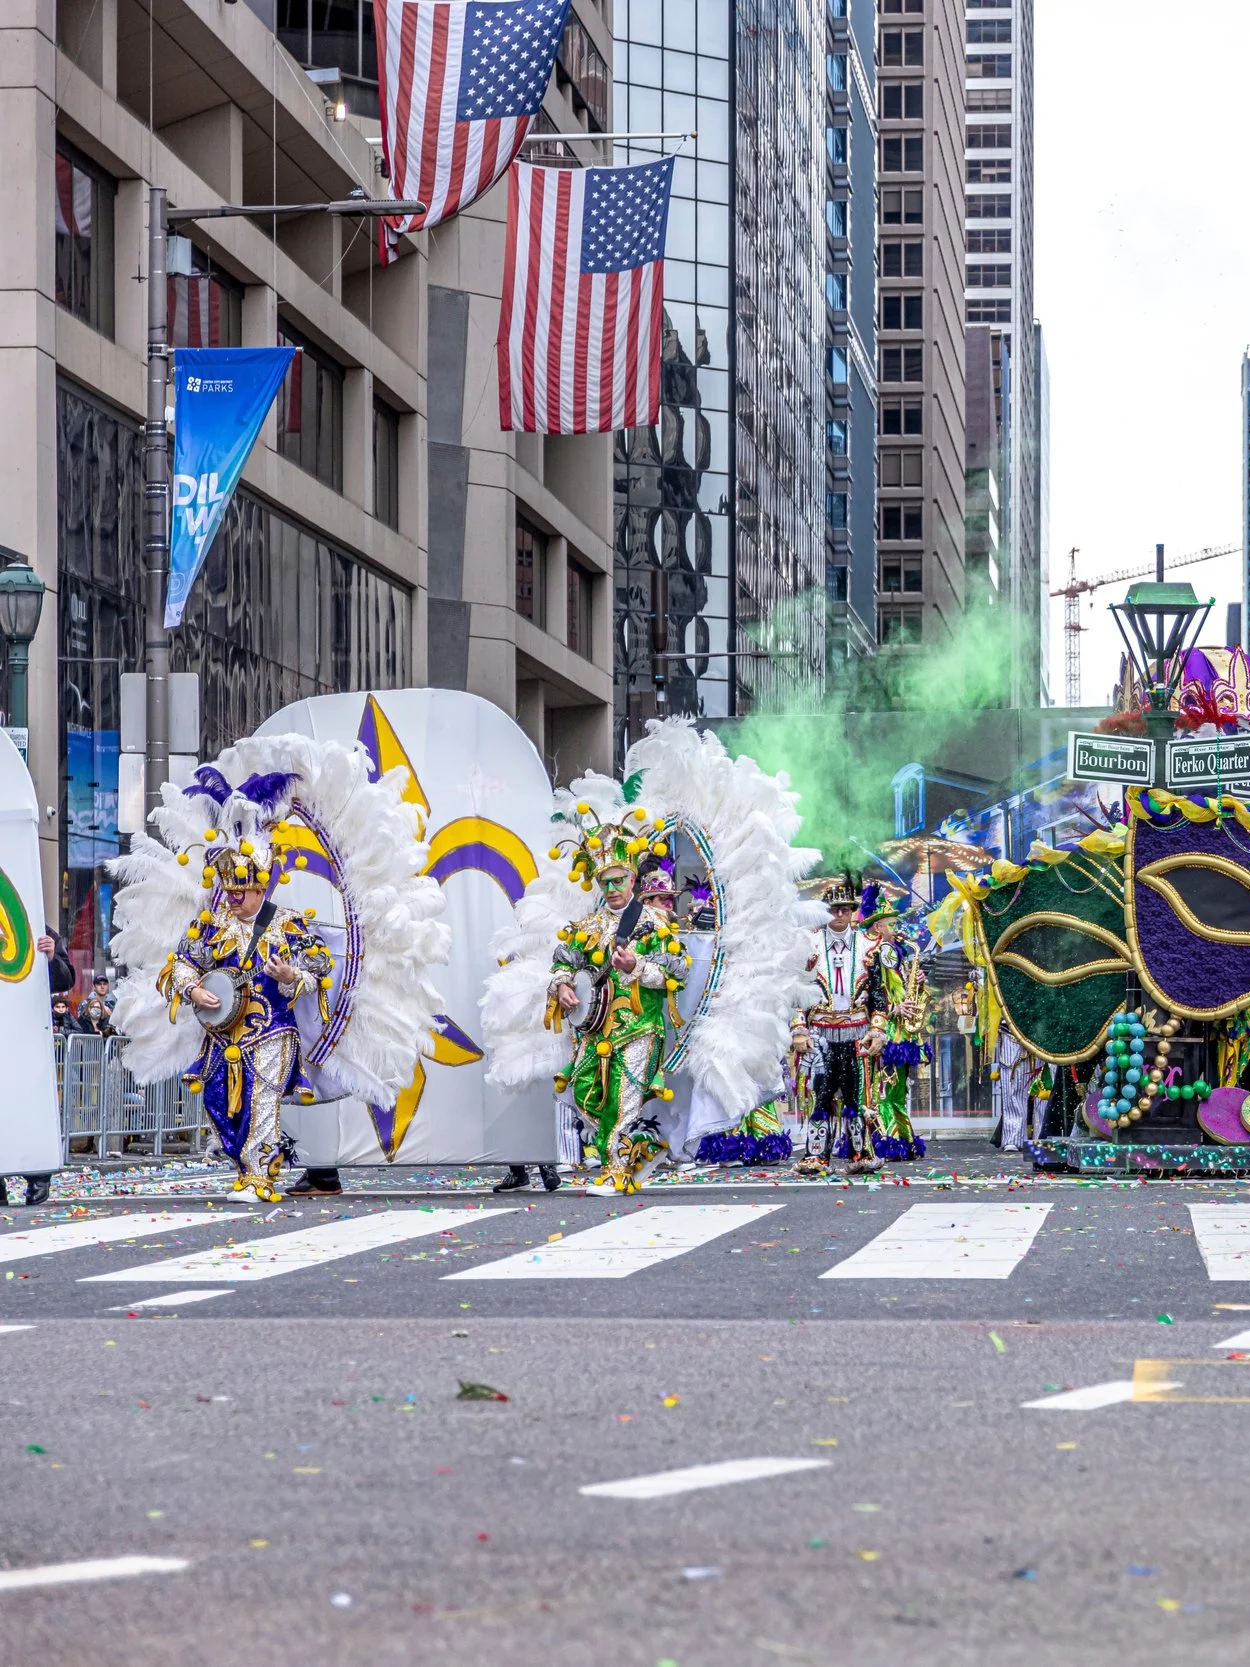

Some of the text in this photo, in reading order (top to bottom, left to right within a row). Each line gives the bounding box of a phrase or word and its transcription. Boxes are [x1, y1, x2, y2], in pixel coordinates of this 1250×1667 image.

[202, 384, 233, 393] PARKS
[1079, 750, 1147, 773] Bourbon
[1174, 755, 1205, 775] Ferko
